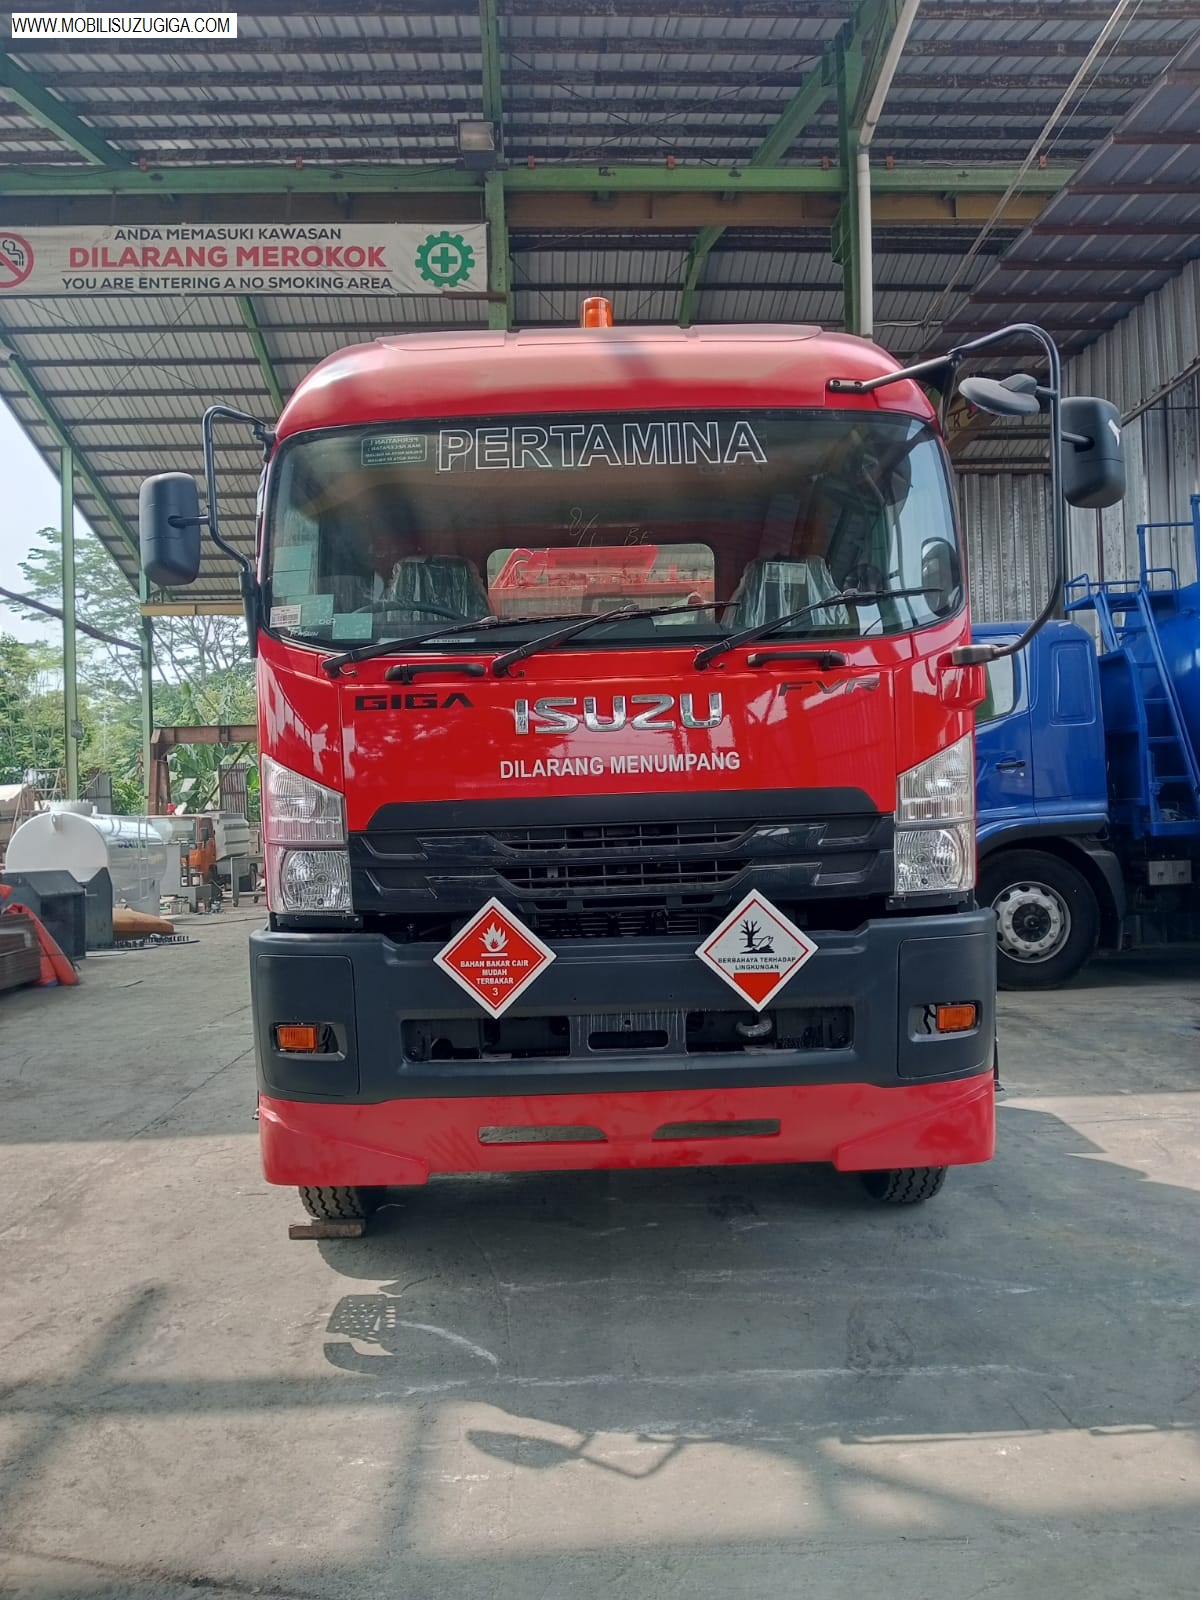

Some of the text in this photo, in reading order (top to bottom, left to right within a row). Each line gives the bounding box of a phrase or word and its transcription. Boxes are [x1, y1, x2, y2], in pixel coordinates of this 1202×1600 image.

[114, 227, 342, 241] ANDA MEMASUKI KAWASAN
[69, 245, 387, 268] DILARANG MEROKOK
[62, 276, 393, 290] YOU ARE ENTERING A NO SMOKING AREA
[438, 420, 768, 471] PERTAMINA
[778, 677, 880, 697] FVR
[355, 692, 475, 711] GIGA
[514, 691, 724, 735] ISUZU
[500, 751, 741, 779] DILARANG MENUMPANG
[492, 987, 499, 996] 3
